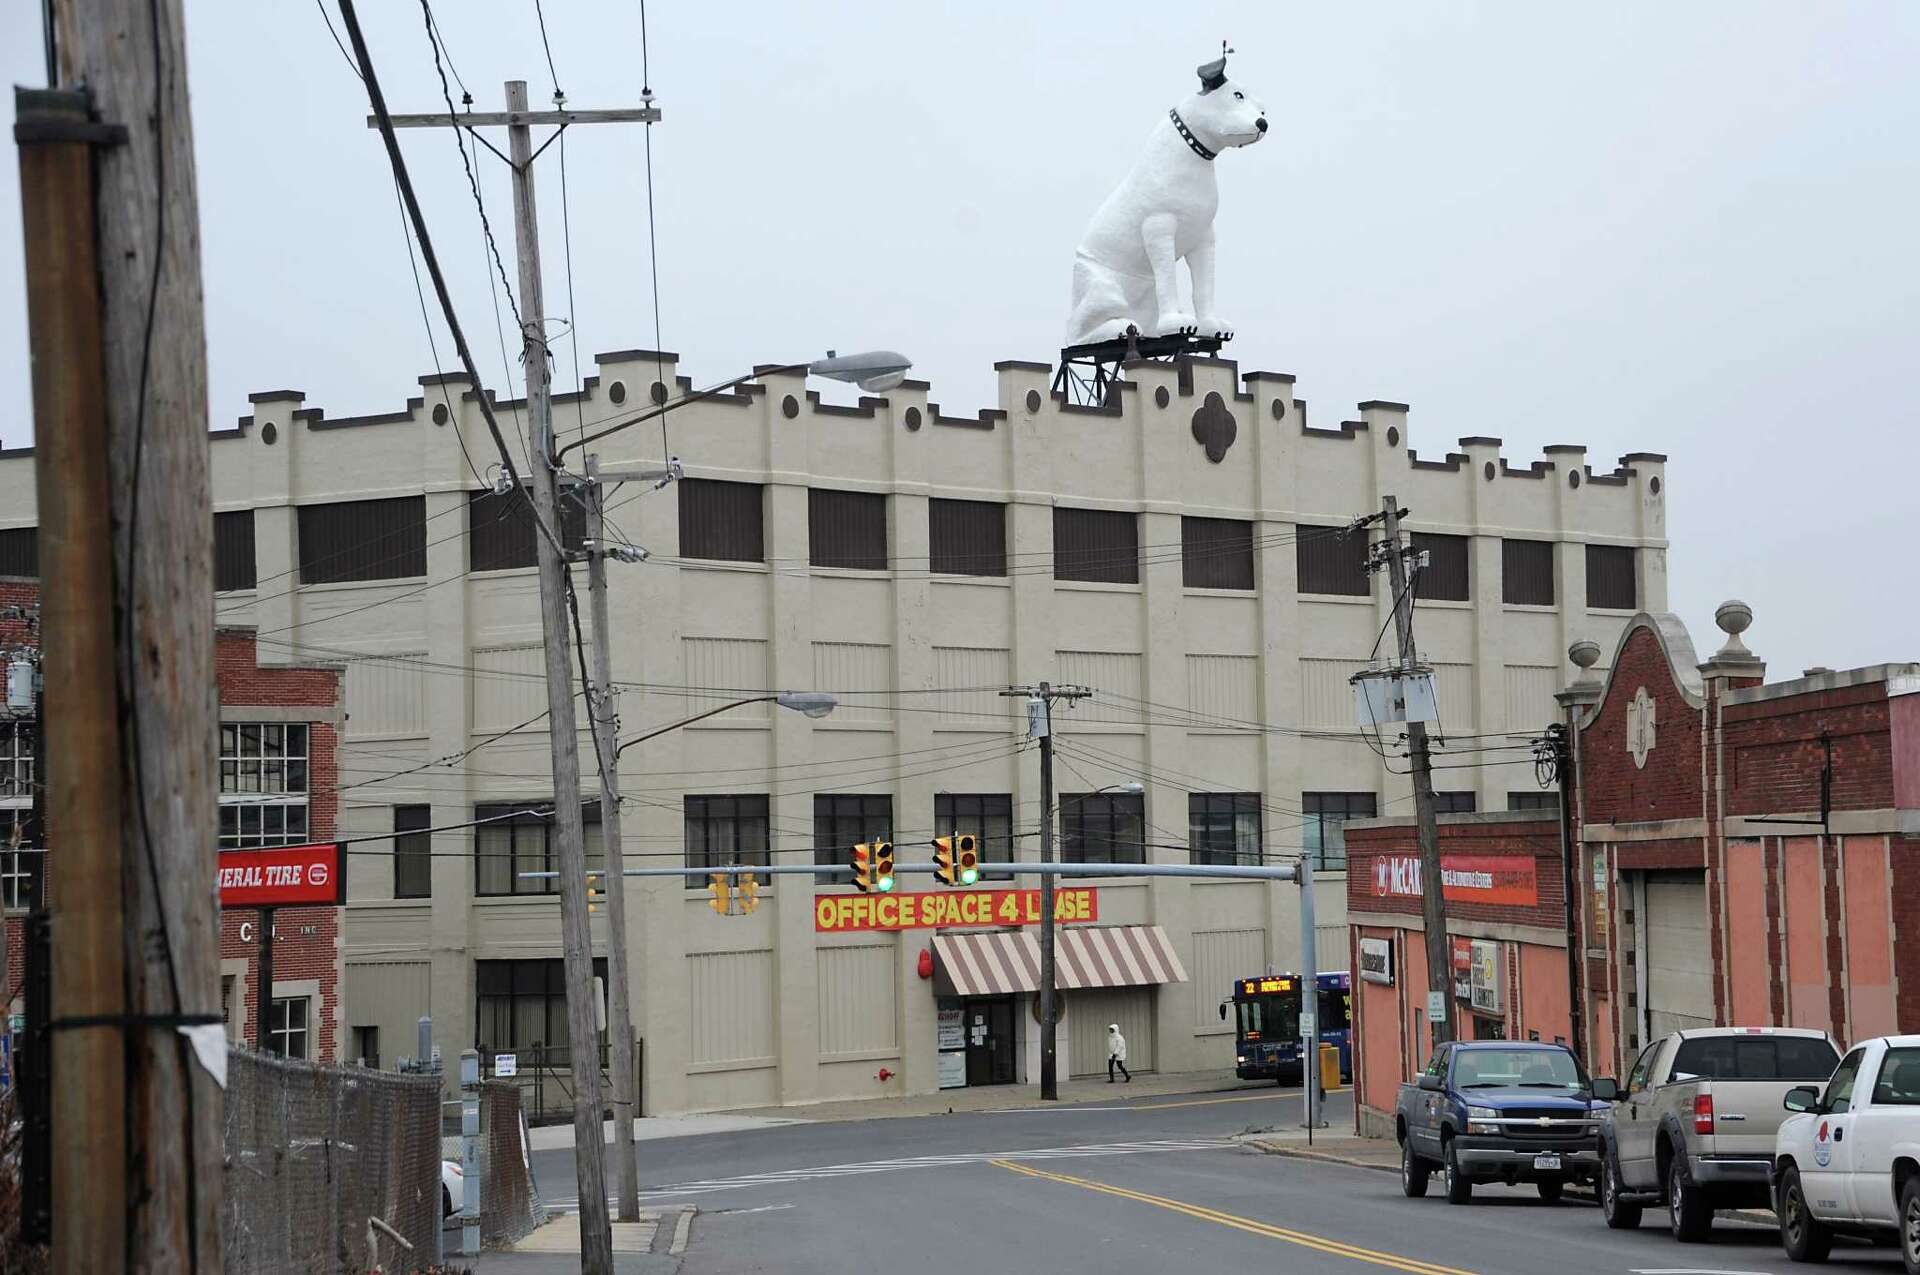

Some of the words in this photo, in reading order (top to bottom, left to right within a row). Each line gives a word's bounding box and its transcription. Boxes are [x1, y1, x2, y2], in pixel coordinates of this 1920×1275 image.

[266, 865, 303, 886] TIRE
[1391, 857, 1424, 896] McCAR
[817, 897, 915, 928] OFFICE
[920, 894, 993, 925] SPACE
[1000, 893, 1019, 922] 4
[1026, 891, 1090, 921] LASE
